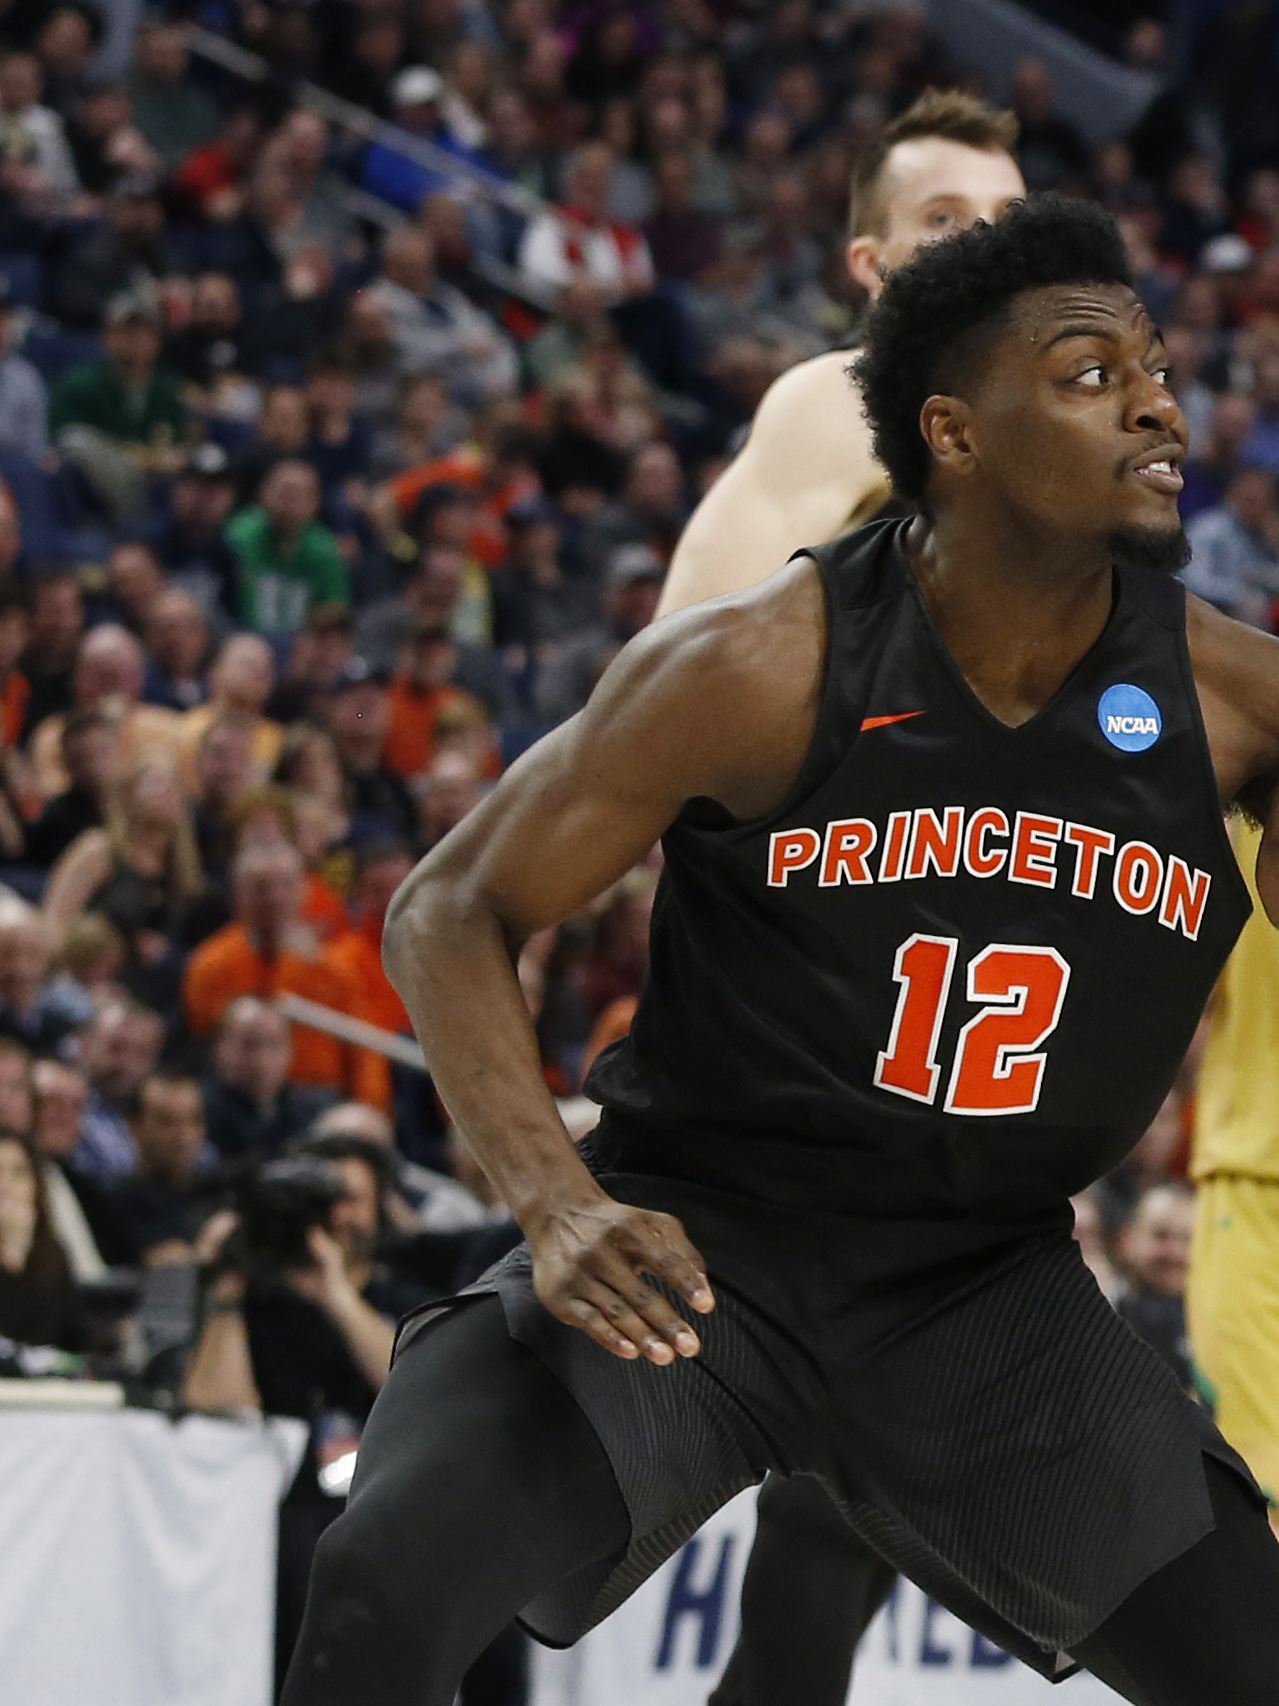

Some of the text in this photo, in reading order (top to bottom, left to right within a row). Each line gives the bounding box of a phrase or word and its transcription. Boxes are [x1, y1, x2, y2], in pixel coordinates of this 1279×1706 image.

[1106, 715, 1159, 735] NCAA
[766, 806, 1211, 942] PRINCETON
[873, 932, 1071, 1117] 12
